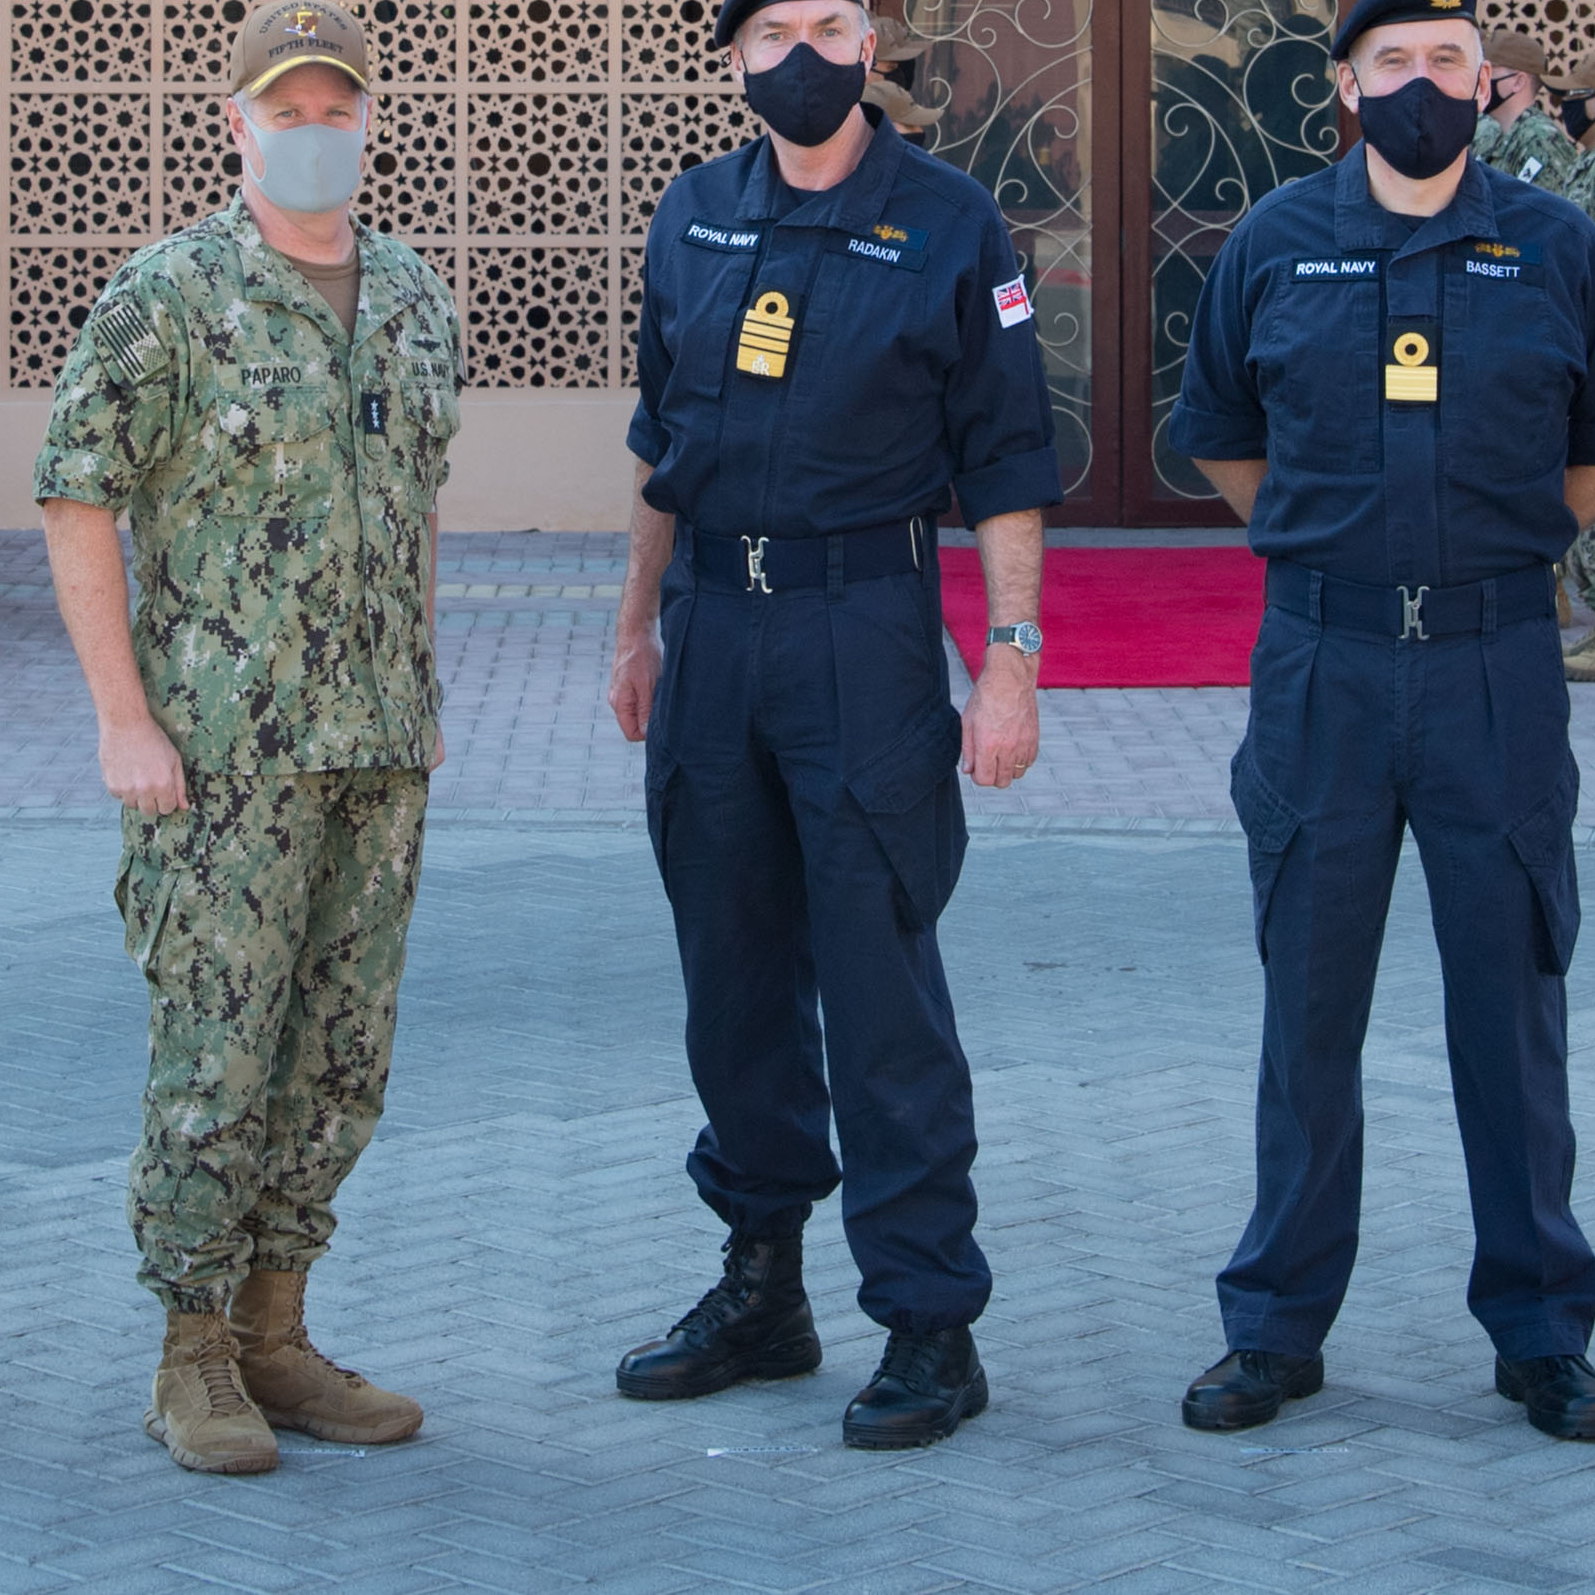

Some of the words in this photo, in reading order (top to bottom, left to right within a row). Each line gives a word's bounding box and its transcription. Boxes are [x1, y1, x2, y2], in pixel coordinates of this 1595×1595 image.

[259, 2, 299, 34] UNITED
[304, 2, 348, 30] STATES
[268, 38, 304, 59] FIFTH
[308, 38, 344, 54] FLEET
[688, 224, 727, 245] ROYAL
[728, 233, 758, 247] NAVY
[848, 239, 901, 263] RADAKIN
[1296, 262, 1337, 275] ROYAL
[1340, 261, 1376, 274] NAVY
[1466, 260, 1520, 278] BASSETT
[241, 366, 301, 385] PAPARO
